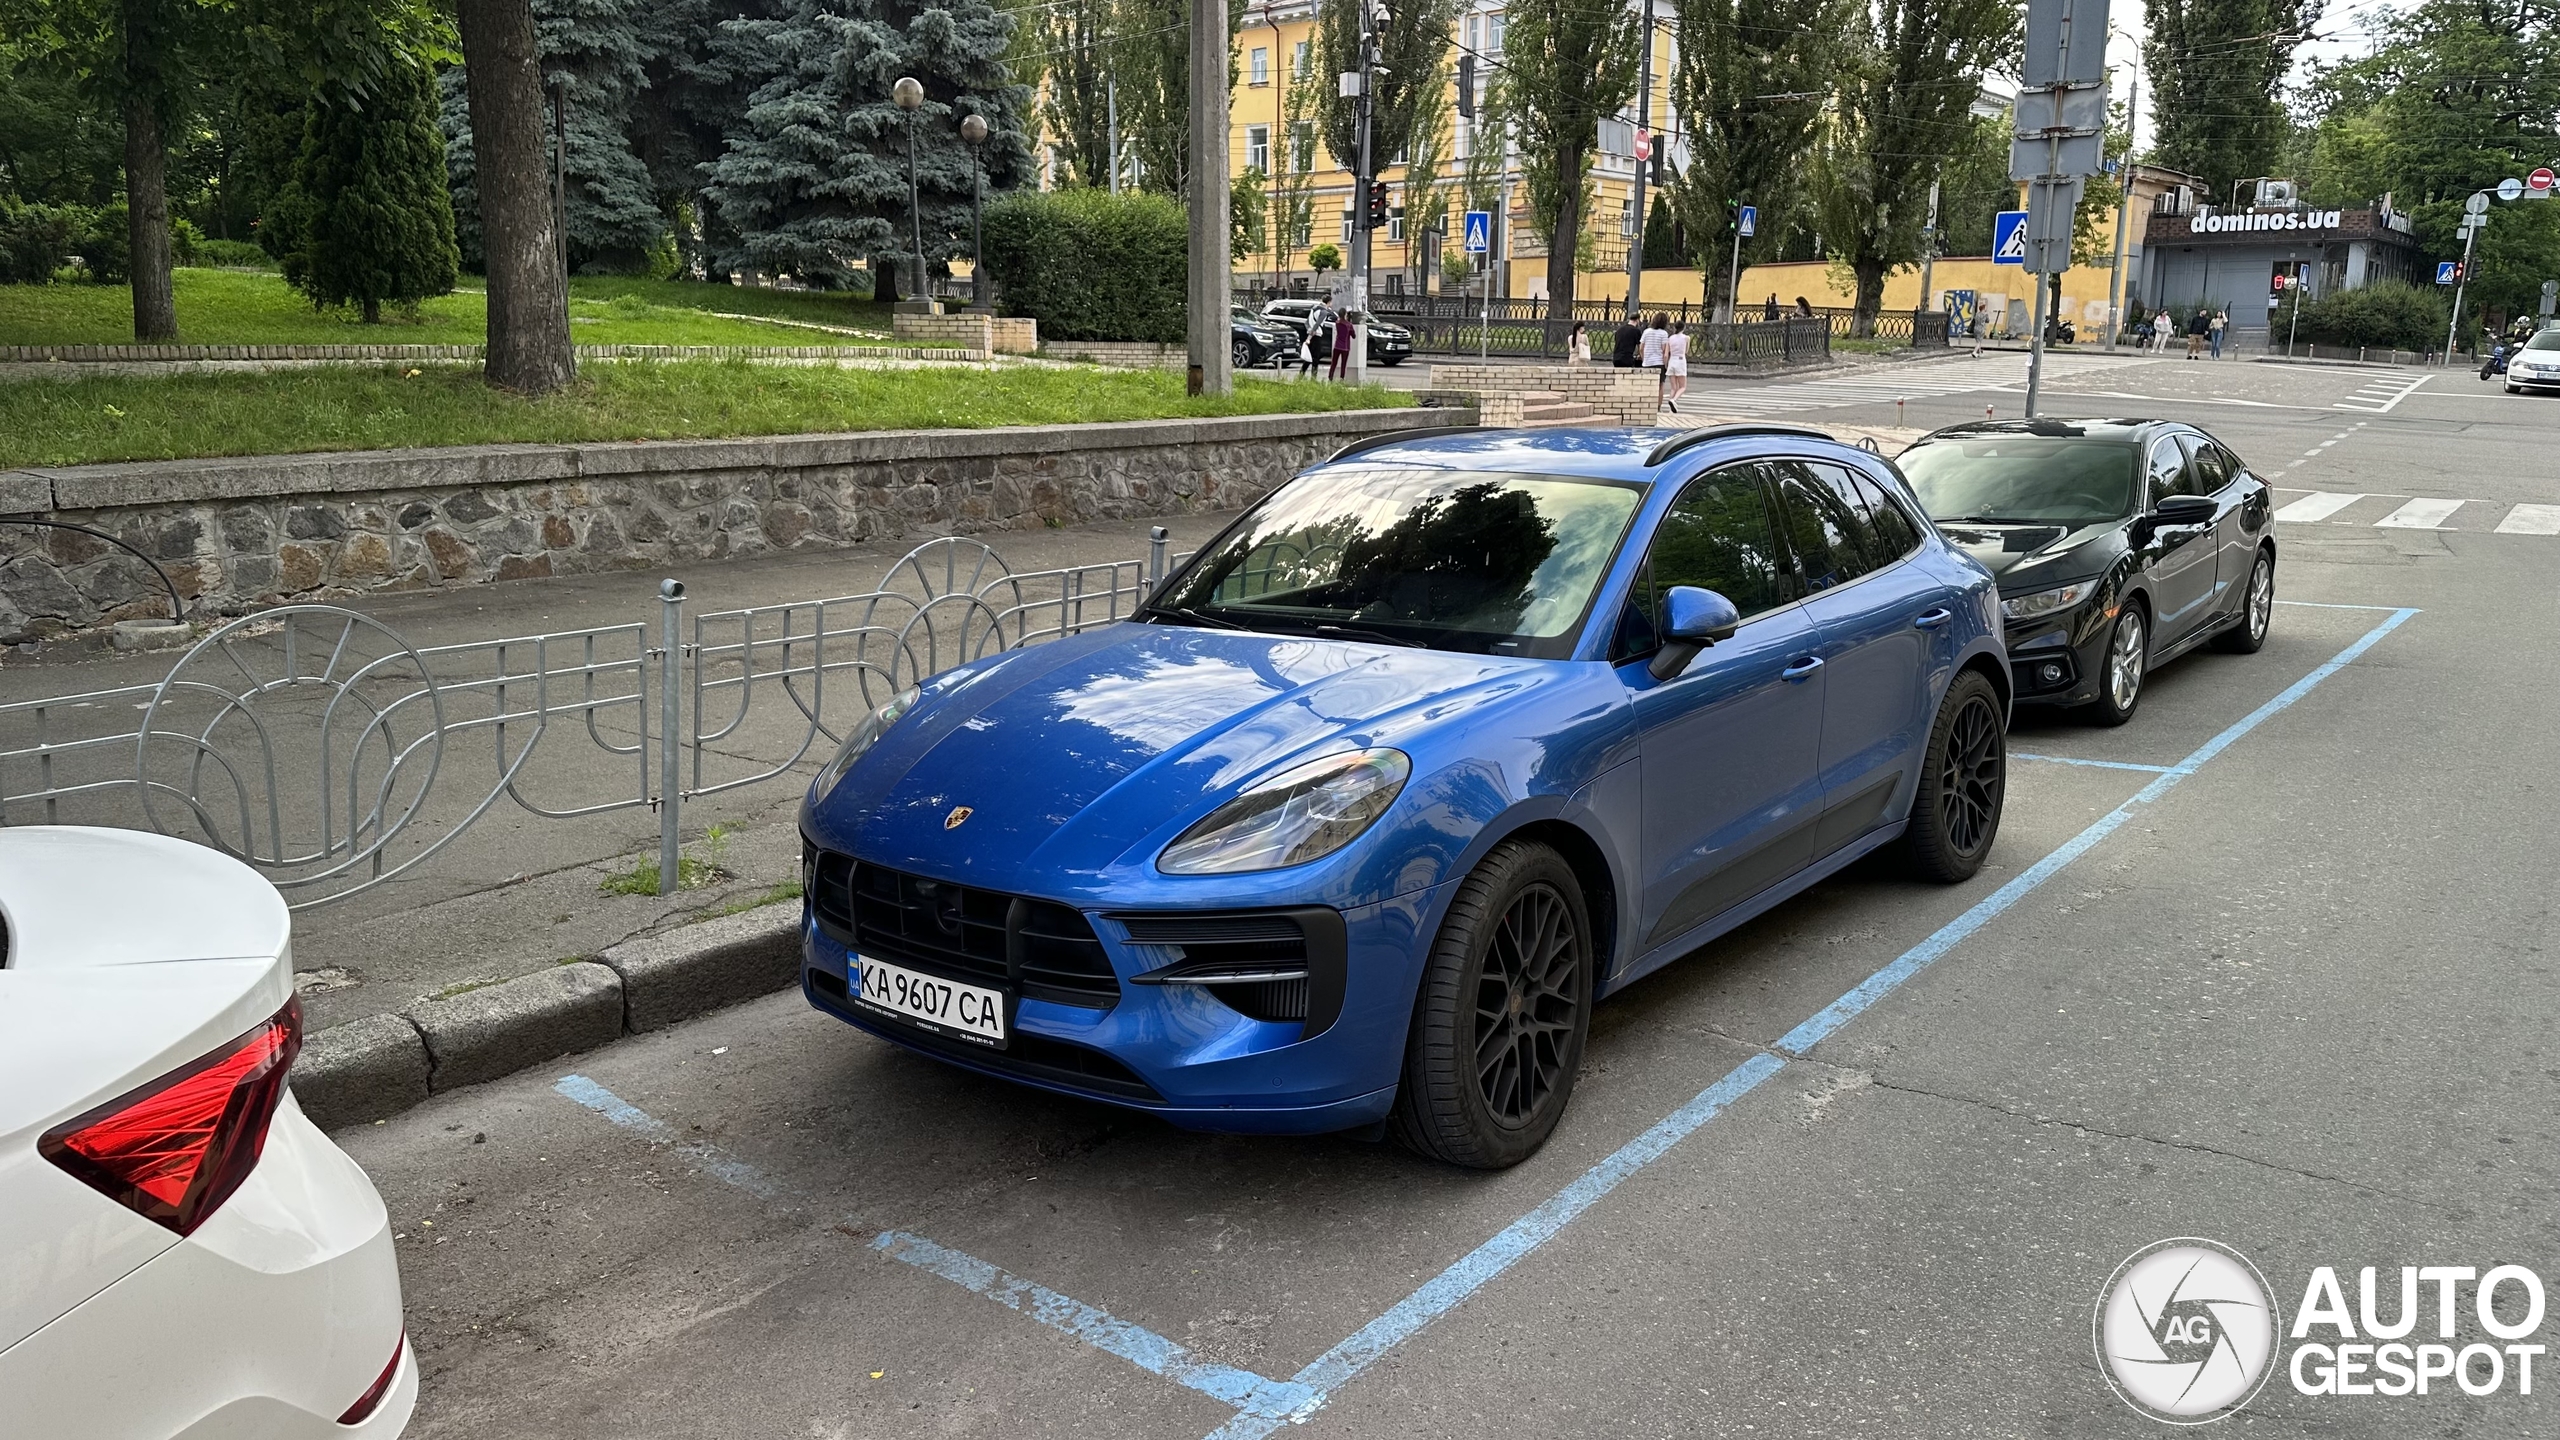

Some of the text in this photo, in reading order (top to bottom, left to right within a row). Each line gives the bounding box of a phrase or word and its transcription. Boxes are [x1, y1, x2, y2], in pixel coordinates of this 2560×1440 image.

[2191, 207, 2341, 233] dominos.ua
[850, 978, 860, 992] UA
[860, 961, 891, 1002] KA
[896, 974, 952, 1018] 9607
[958, 991, 998, 1031] CA
